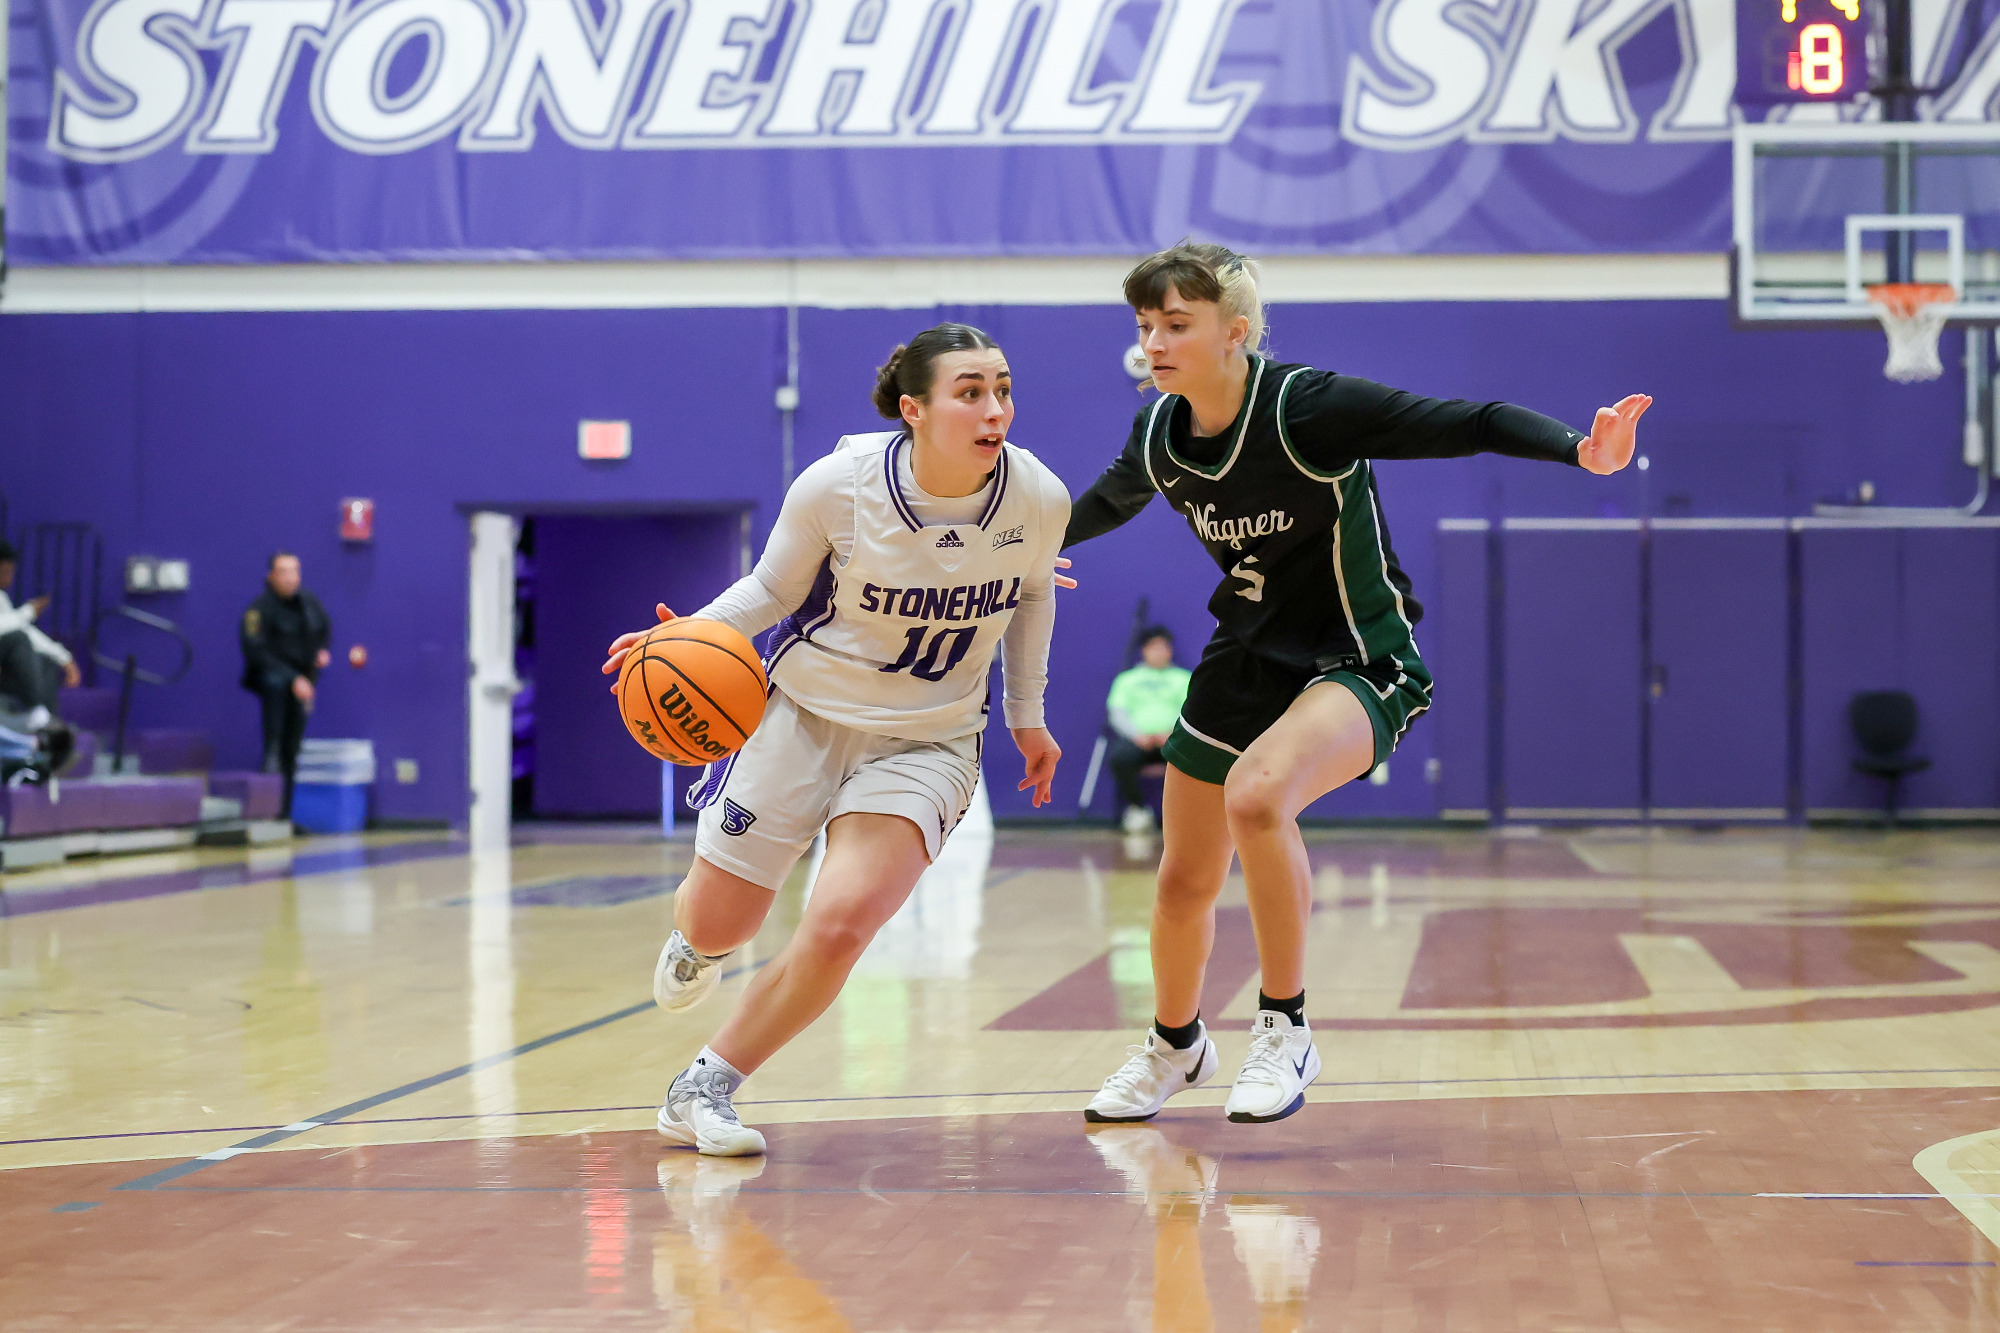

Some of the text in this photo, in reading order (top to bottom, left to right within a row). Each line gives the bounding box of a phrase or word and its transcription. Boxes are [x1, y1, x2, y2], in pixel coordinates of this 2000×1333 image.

[47, 0, 1265, 164] STONEHILL
[935, 540, 964, 548] adidas
[992, 525, 1024, 549] NEC
[1185, 500, 1294, 550] Wagner
[859, 577, 1021, 621] STONEHILL
[1231, 555, 1265, 602] 5
[878, 625, 978, 682] 10
[659, 683, 731, 758] Wilson
